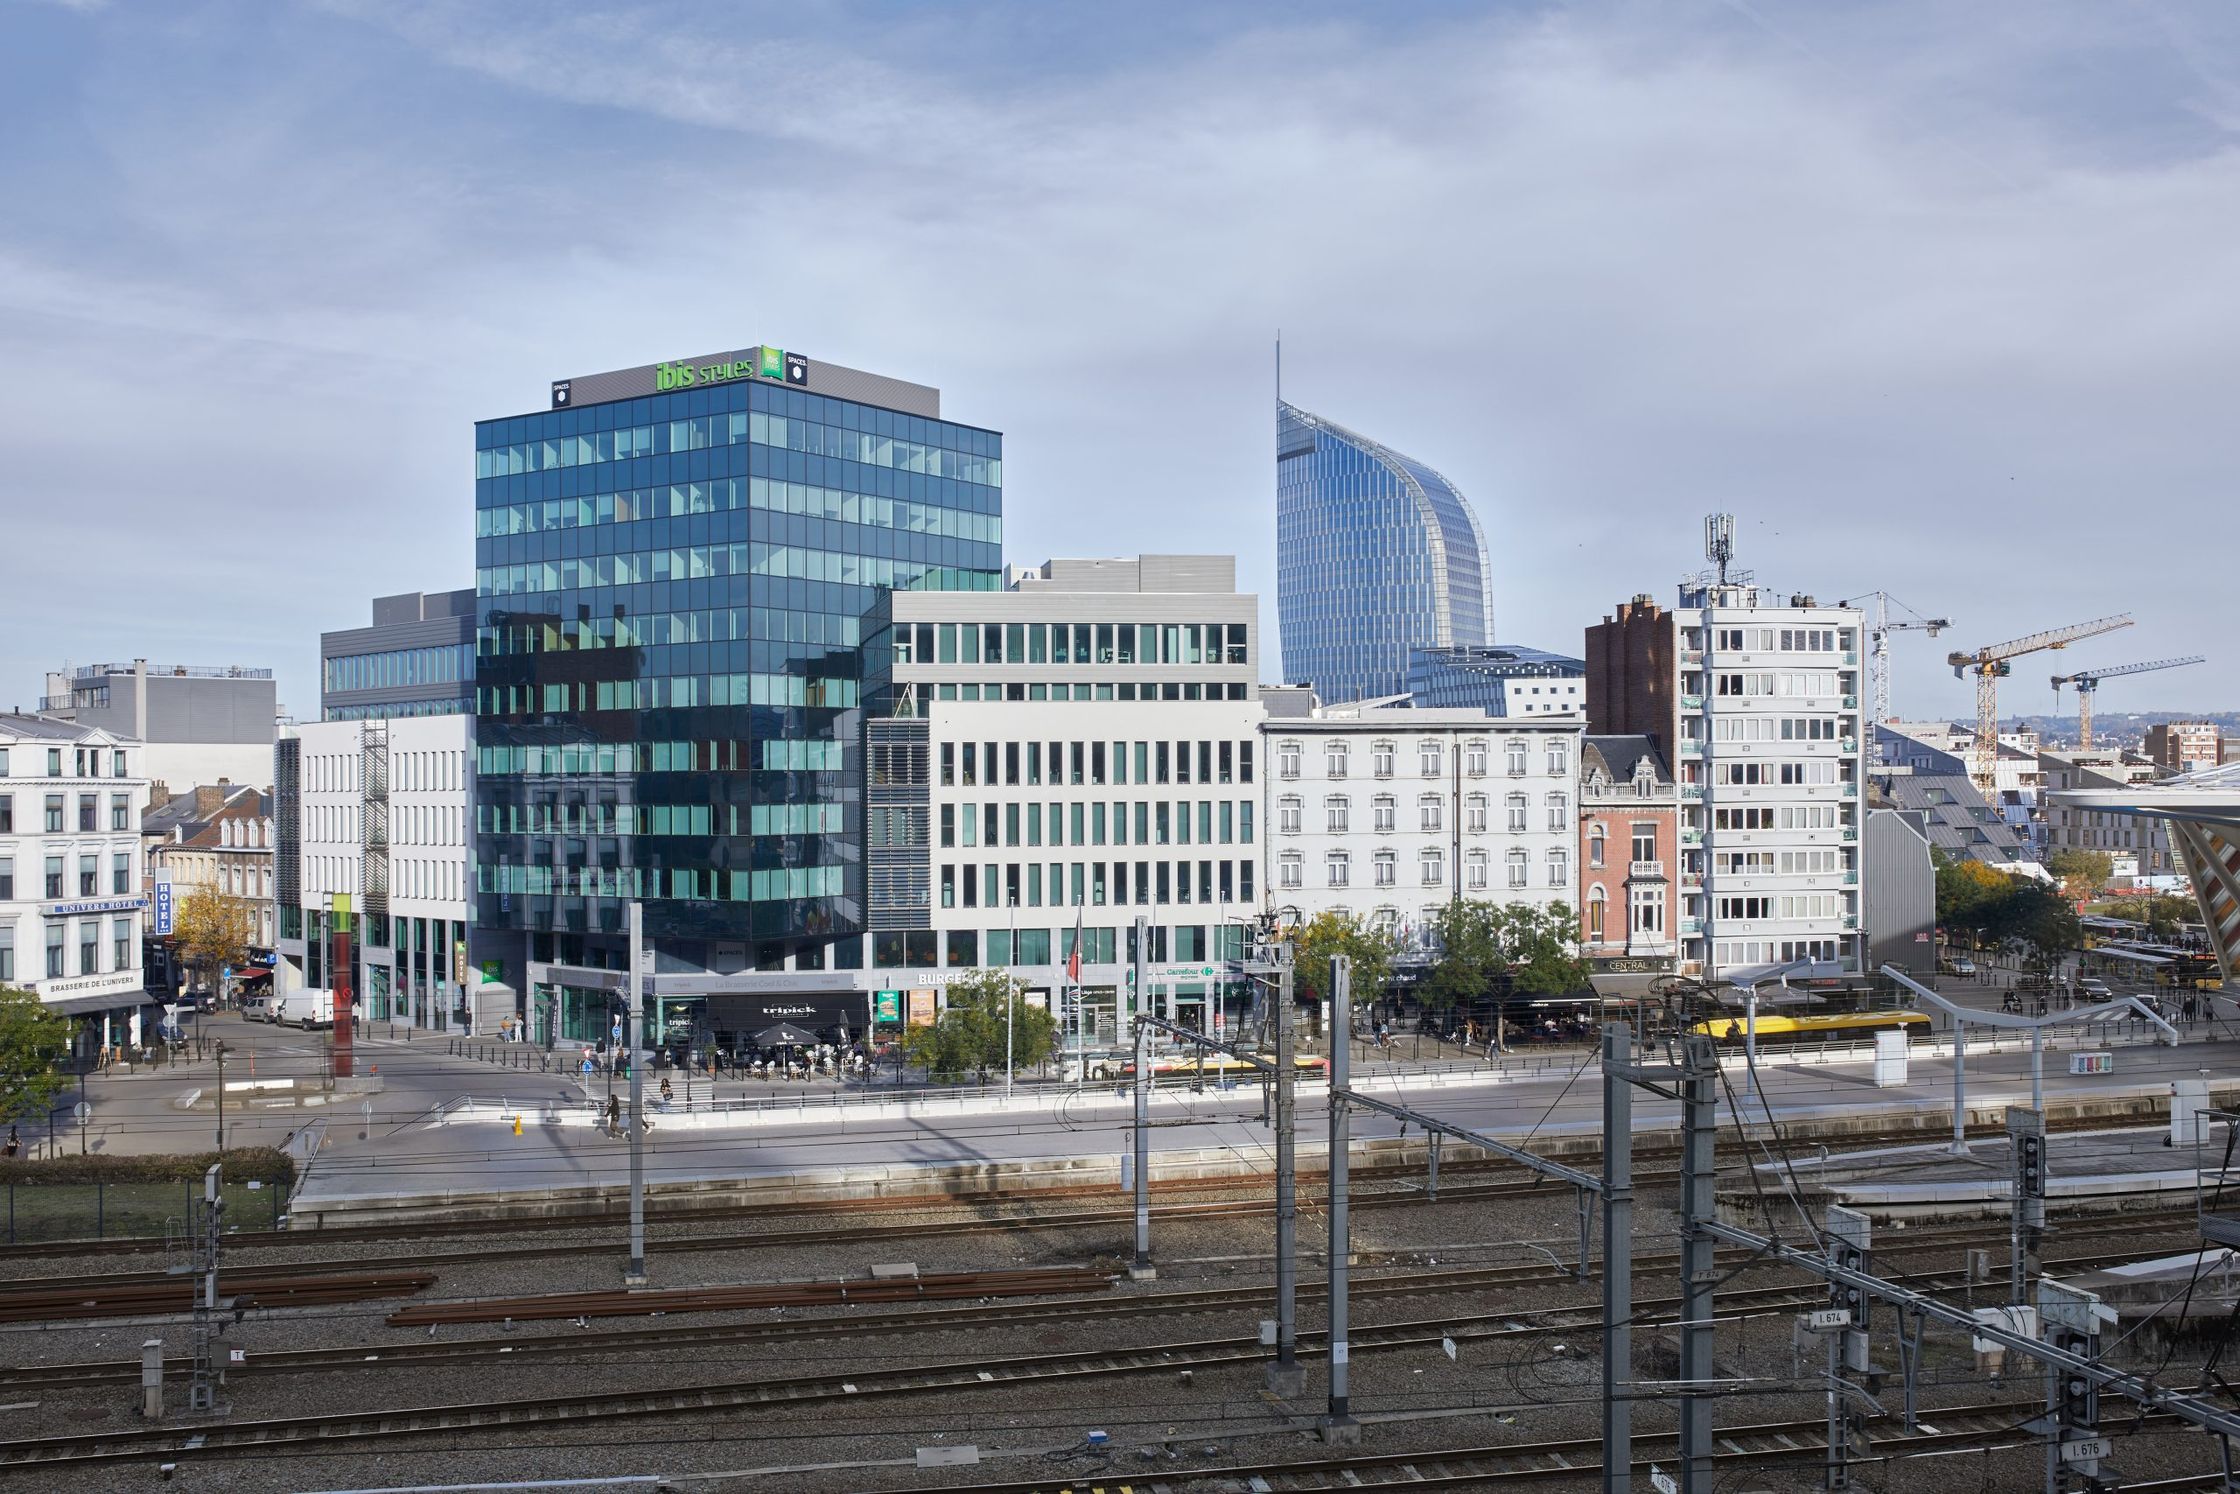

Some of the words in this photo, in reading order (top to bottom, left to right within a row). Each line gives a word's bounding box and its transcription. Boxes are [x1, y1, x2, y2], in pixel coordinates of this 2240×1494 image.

[655, 361, 695, 392] ibis
[63, 902, 105, 912] UNIVERS
[108, 900, 139, 909] HOTEL
[160, 884, 168, 929] HOTEL
[1609, 961, 1648, 970] CENTRAL
[50, 982, 90, 992] BRASSERIE
[102, 976, 134, 986] L'UNIVERS
[763, 1006, 817, 1014] tripick
[235, 1352, 240, 1360] T
